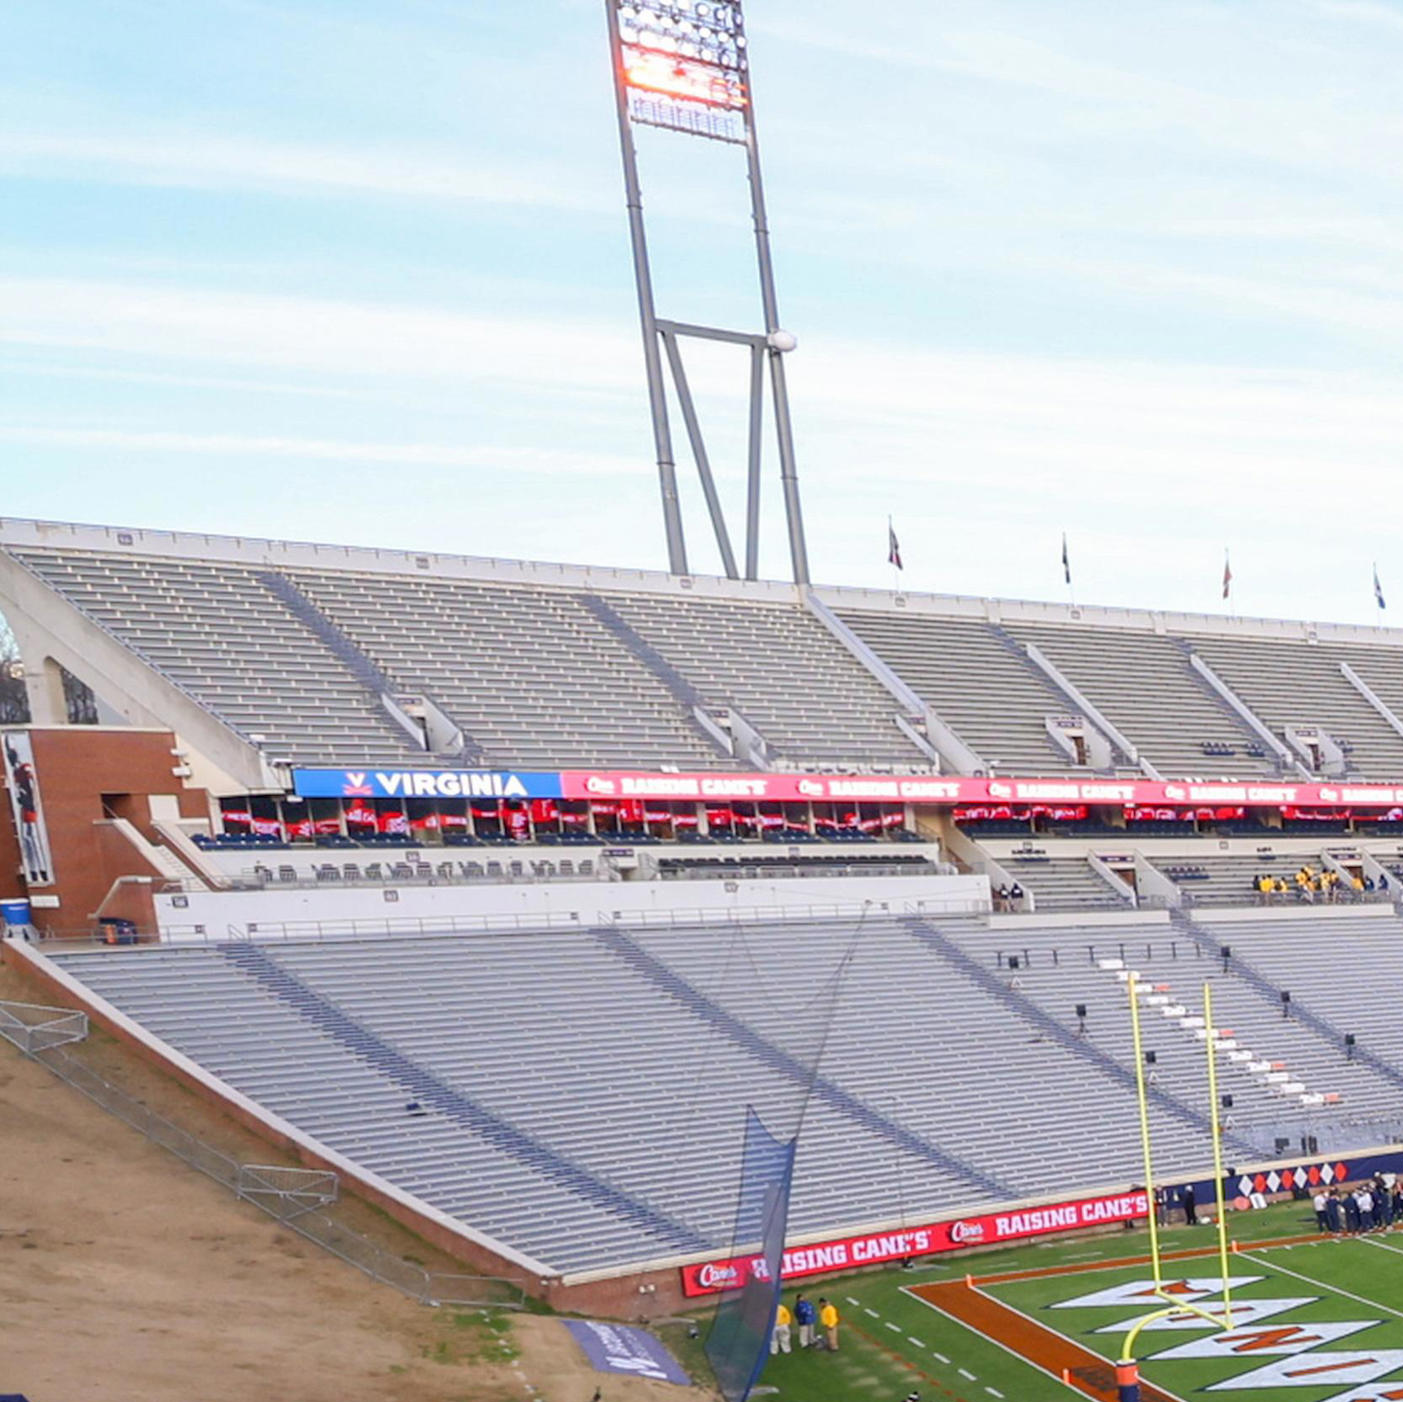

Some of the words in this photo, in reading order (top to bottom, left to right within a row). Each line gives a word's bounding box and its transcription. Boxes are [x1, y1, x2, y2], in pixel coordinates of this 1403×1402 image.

[375, 773, 528, 796] VIRGINIA
[622, 778, 699, 795] RAISING
[752, 1245, 847, 1279] RISING
[852, 1232, 930, 1261] CANE'S
[996, 1208, 1078, 1237] RAISING
[1081, 1195, 1148, 1221] CANE'S
